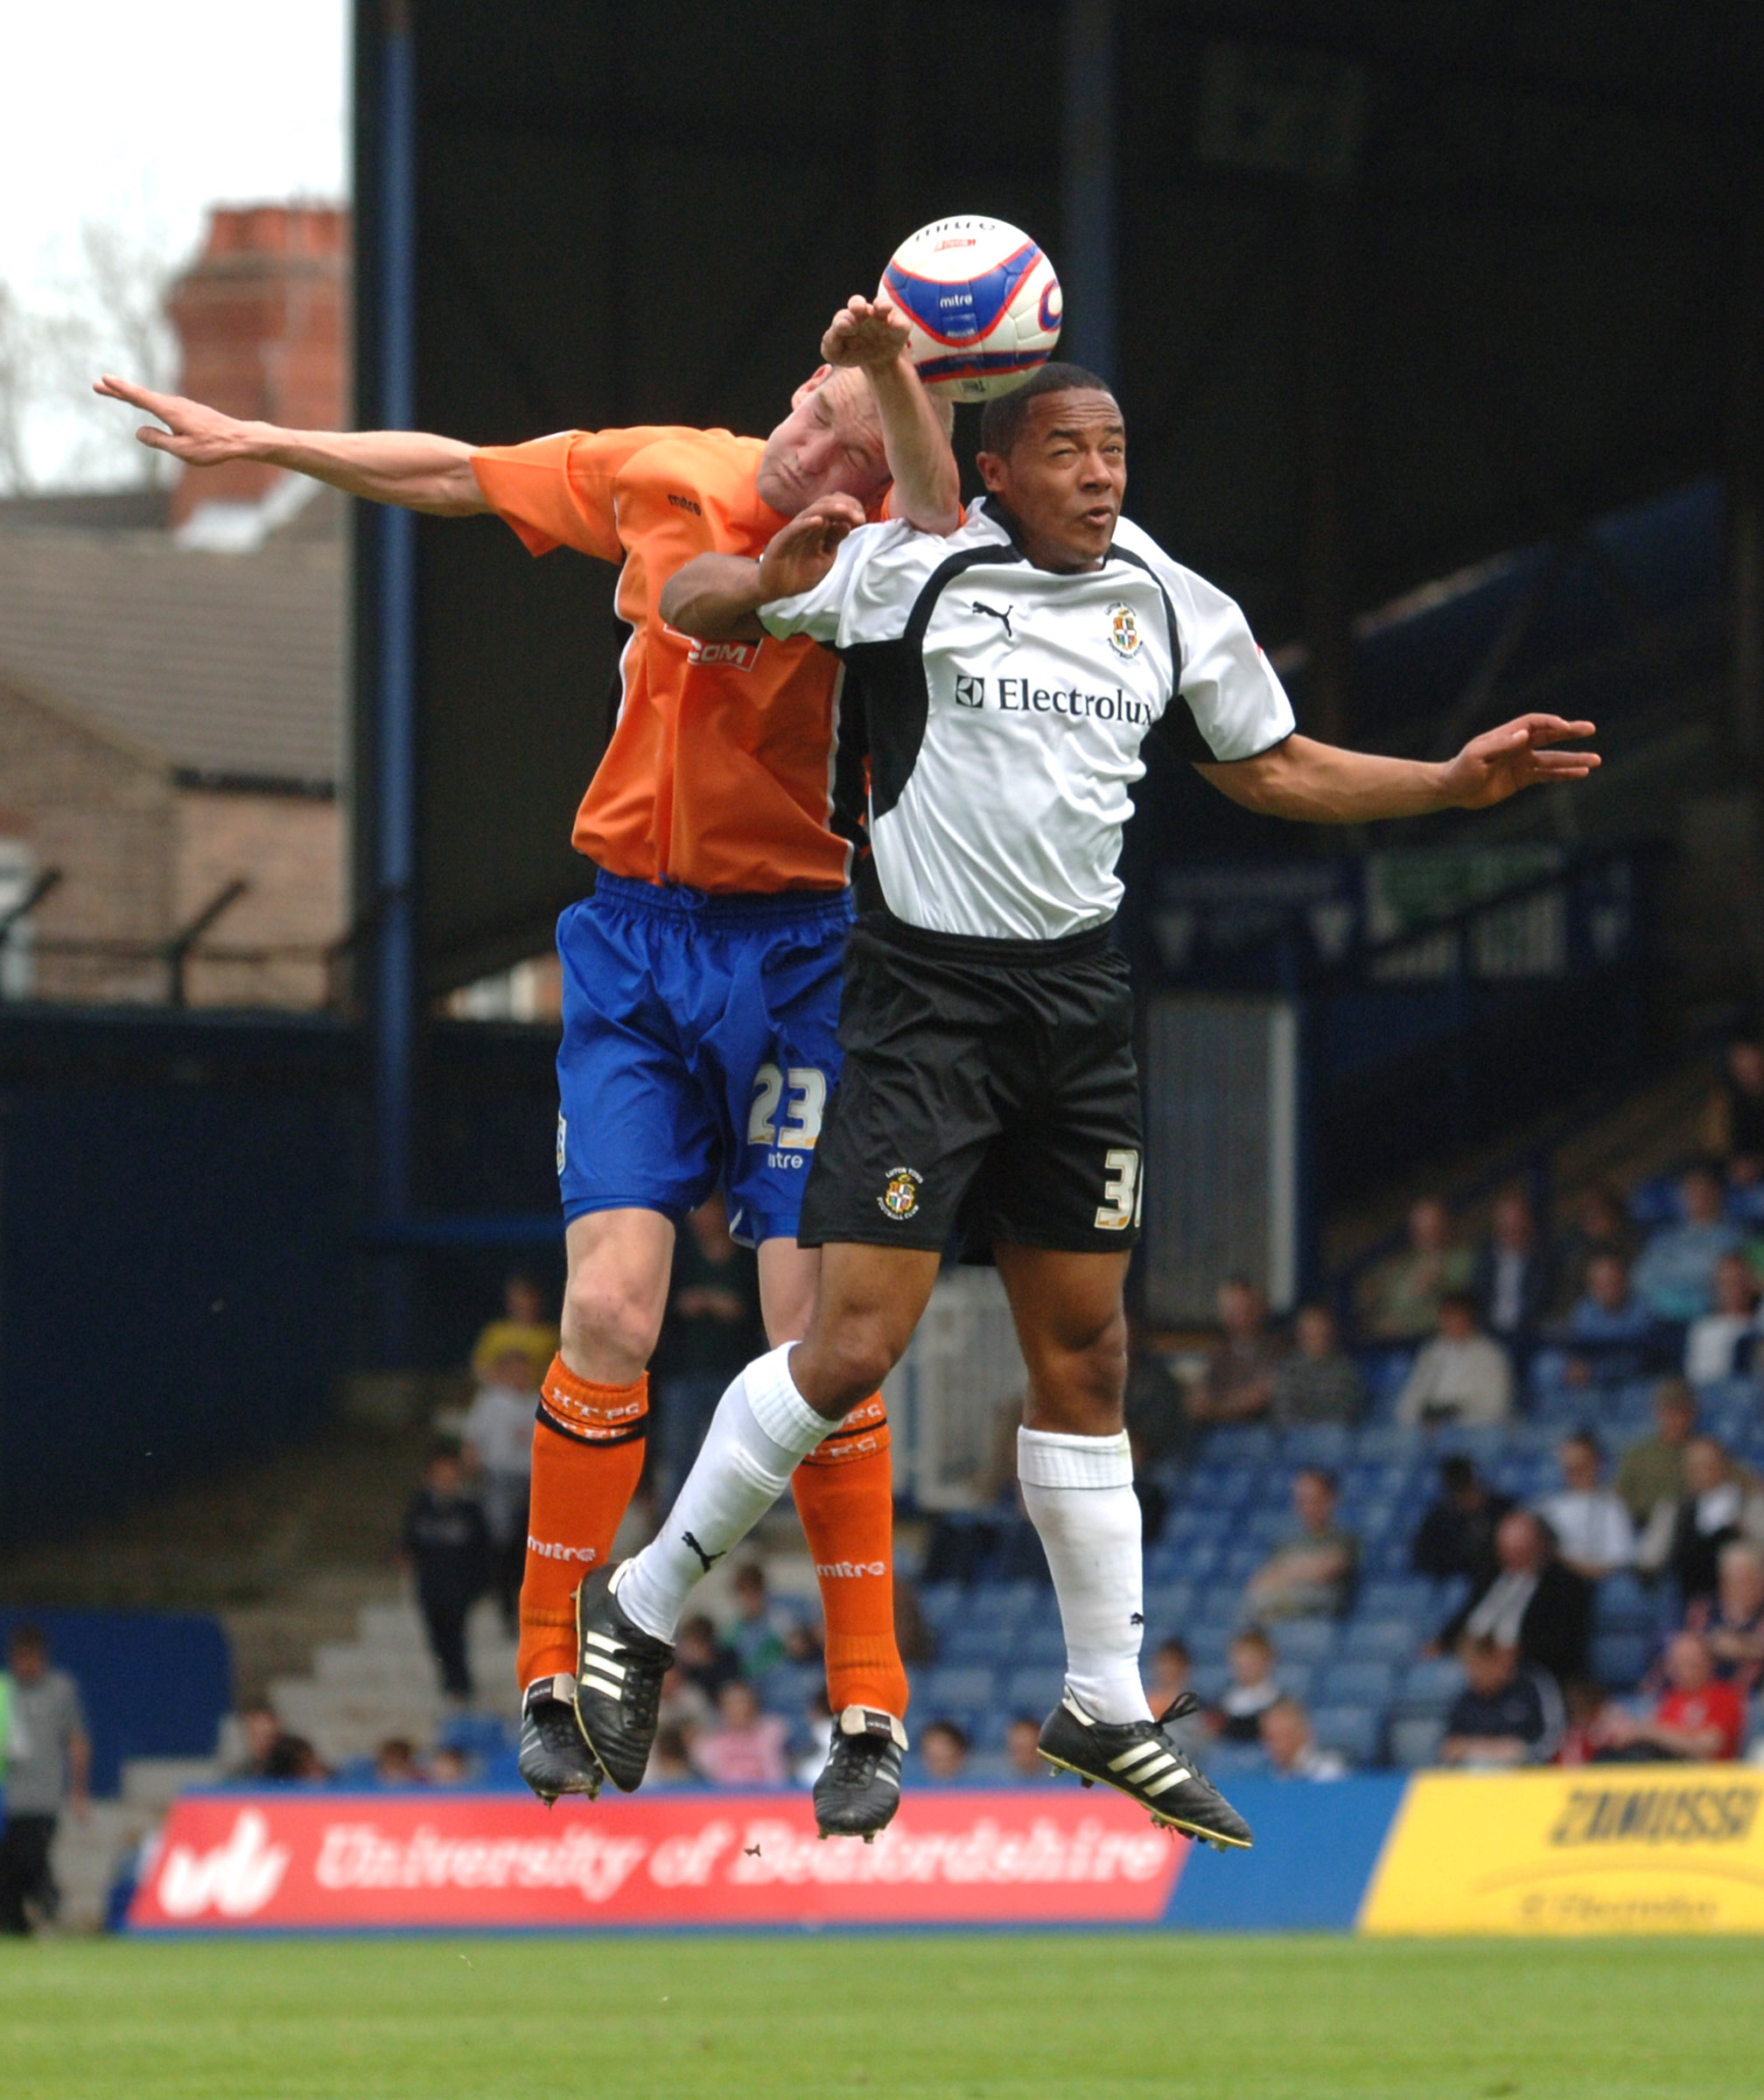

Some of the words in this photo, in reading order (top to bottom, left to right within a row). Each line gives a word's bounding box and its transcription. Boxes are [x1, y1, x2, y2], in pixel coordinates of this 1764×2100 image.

[939, 294, 973, 308] mitre
[998, 678, 1152, 726] Electrolux
[748, 1063, 827, 1151] 23
[1094, 1149, 1144, 1230] 3
[528, 1535, 596, 1563] mitre
[816, 1561, 886, 1578] mitre
[315, 1824, 644, 1904] University
[649, 1820, 733, 1888] of
